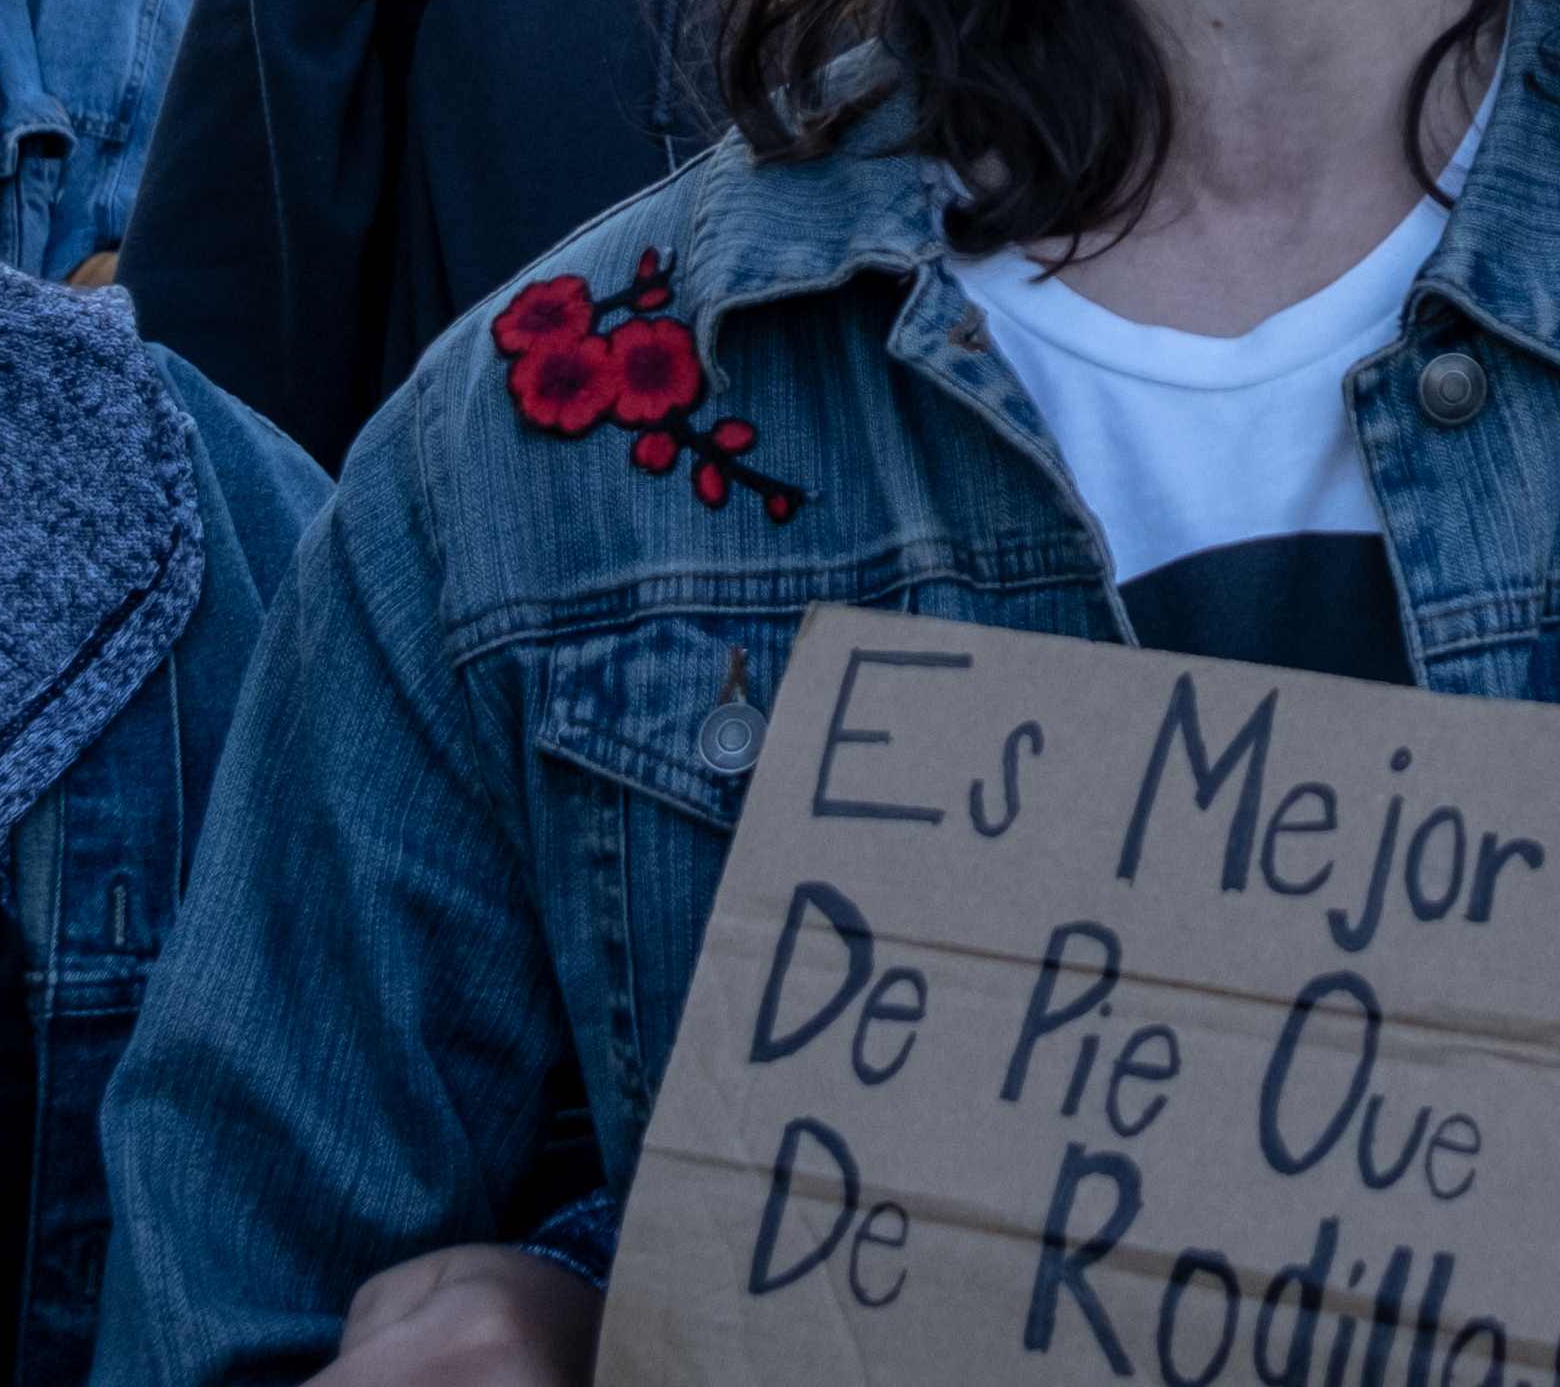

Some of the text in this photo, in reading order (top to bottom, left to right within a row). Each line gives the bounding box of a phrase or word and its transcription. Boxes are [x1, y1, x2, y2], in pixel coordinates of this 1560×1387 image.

[811, 647, 1043, 838] Es
[1114, 673, 1545, 953] Mejor
[748, 880, 926, 1087] De
[999, 922, 1182, 1137] Pie
[748, 1117, 912, 1309] De
